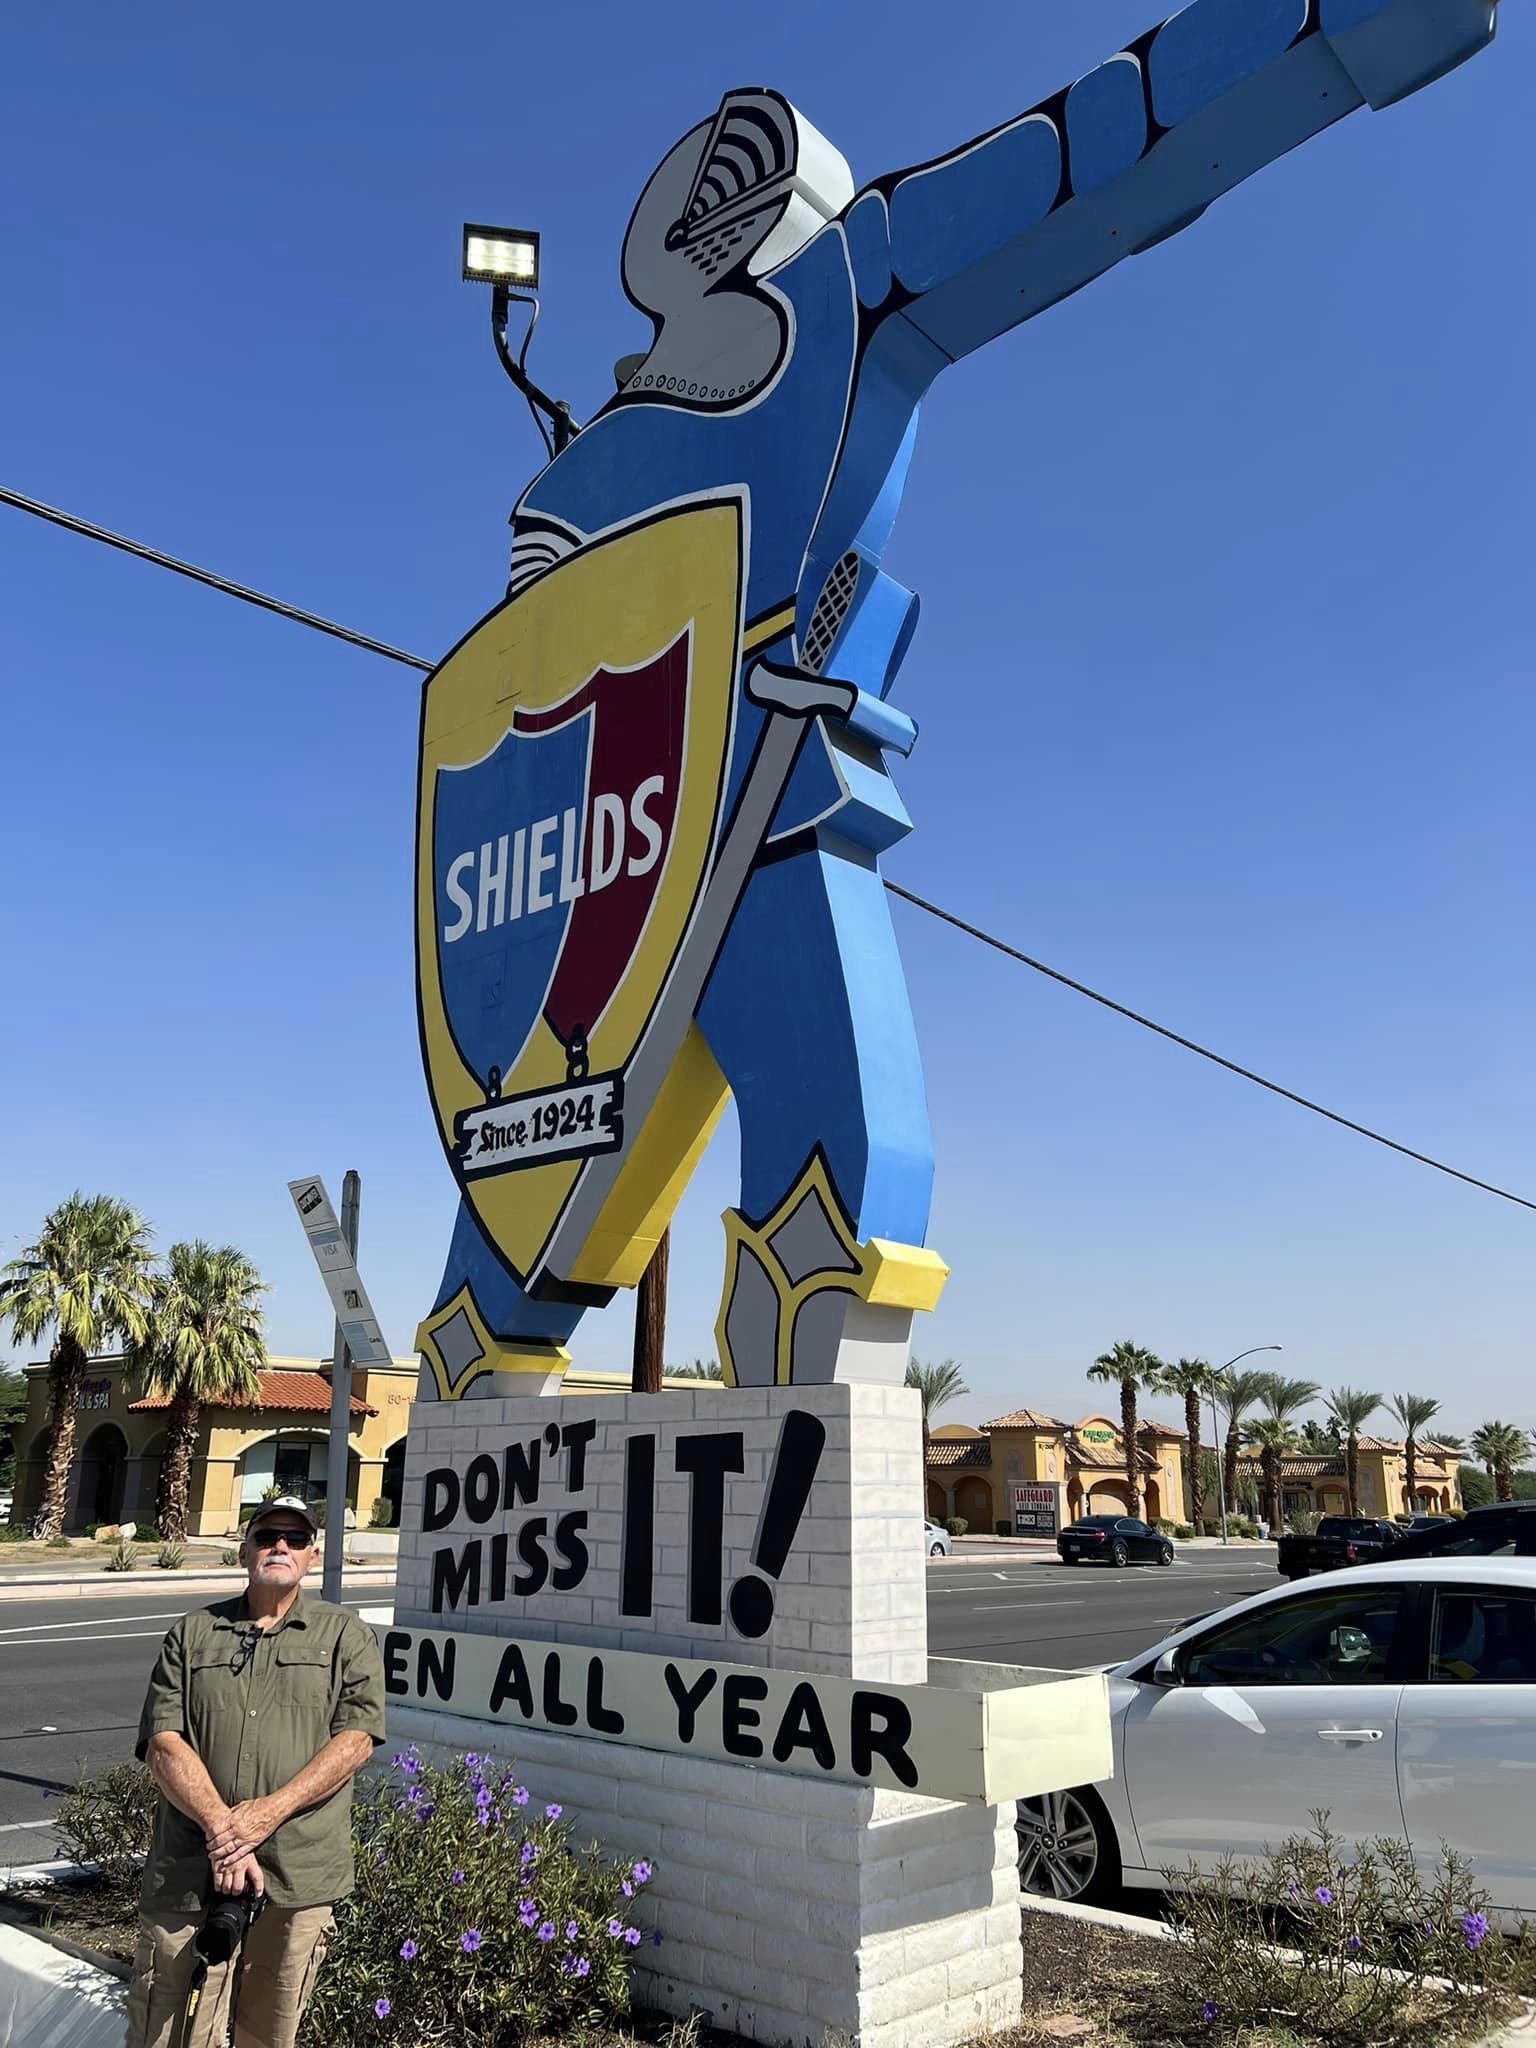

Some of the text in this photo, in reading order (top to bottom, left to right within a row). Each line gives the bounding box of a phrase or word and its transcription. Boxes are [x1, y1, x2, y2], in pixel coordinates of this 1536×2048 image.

[444, 775, 664, 943] SHIELDS
[476, 1095, 594, 1155] Since 1924
[93, 1392, 109, 1409] SPA
[422, 1418, 597, 1533] DON'T
[619, 1409, 826, 1639] IT!
[1016, 1489, 1053, 1502] SAFEGUARD
[431, 1510, 589, 1614] MISS
[489, 1643, 625, 1735] ALL
[664, 1663, 919, 1789] YEAR
